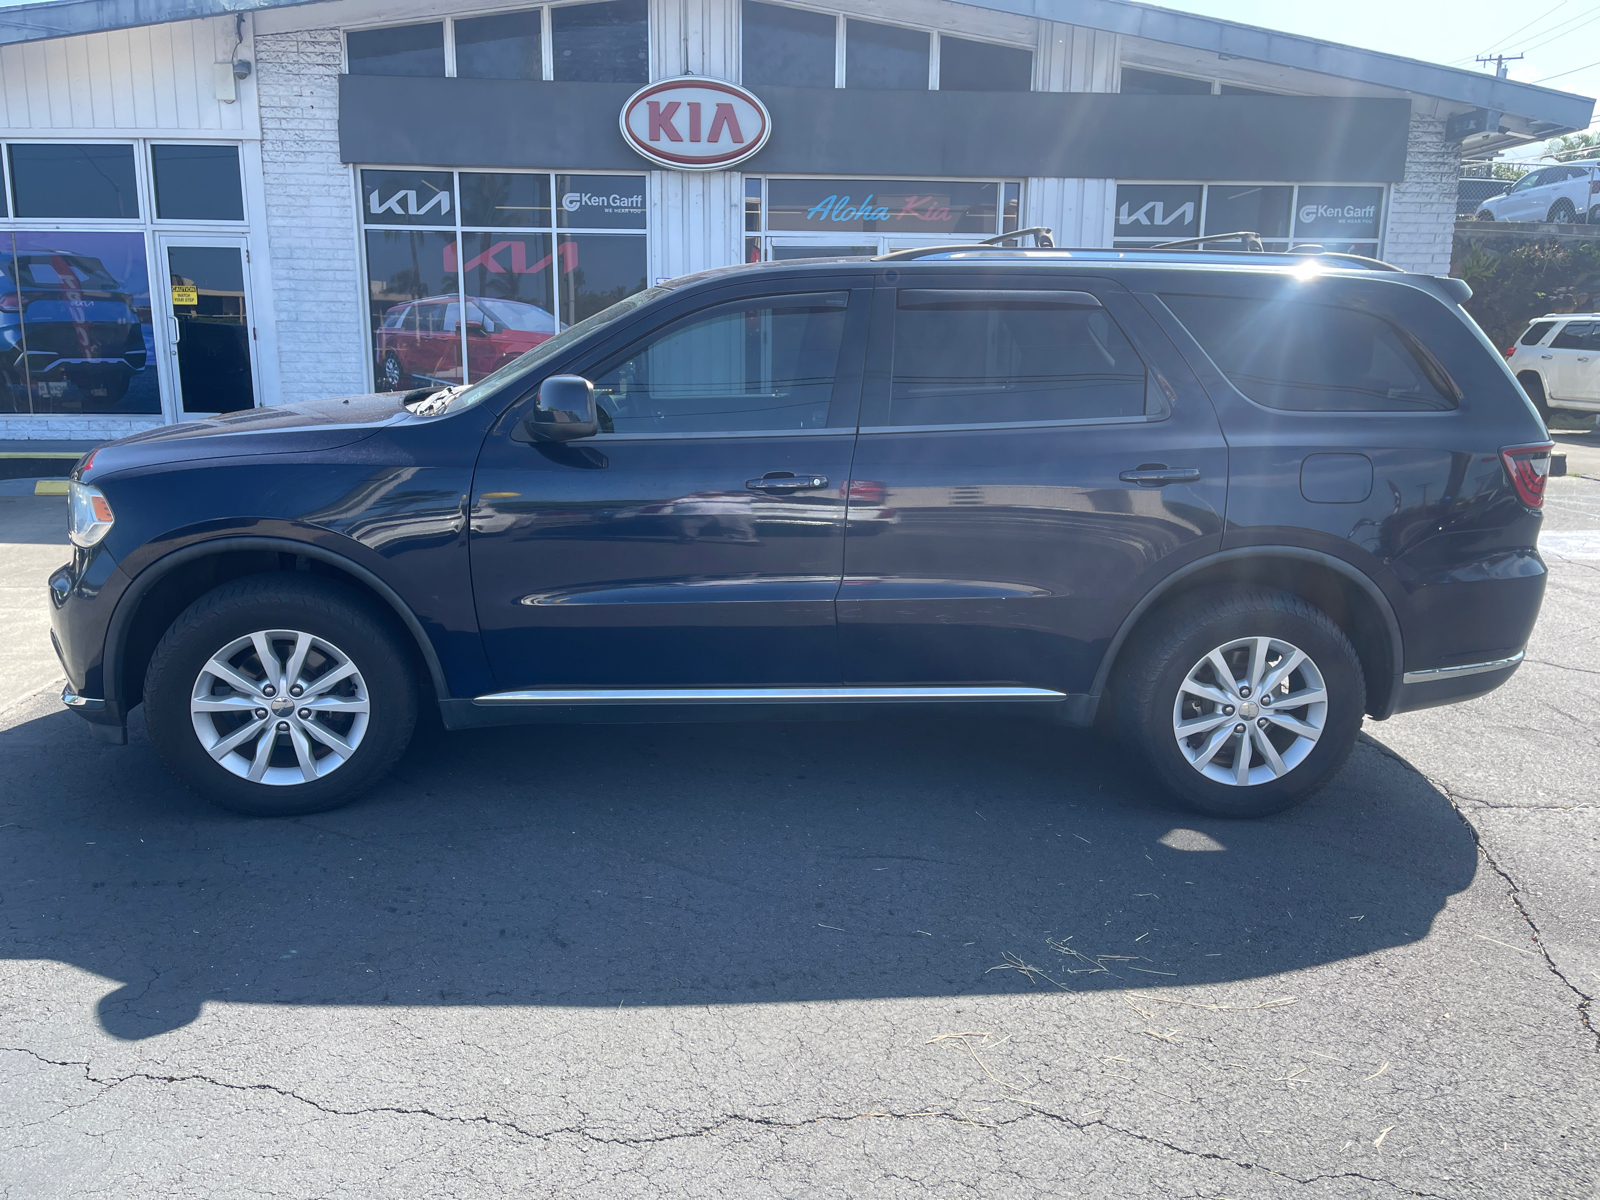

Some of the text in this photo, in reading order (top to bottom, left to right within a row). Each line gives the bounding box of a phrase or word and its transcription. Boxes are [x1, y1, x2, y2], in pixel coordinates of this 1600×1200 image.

[646, 100, 744, 143] KIA
[369, 189, 450, 216] KIA
[581, 192, 643, 207] Ken Garff
[806, 193, 952, 222] Aloha Kia
[1317, 204, 1376, 218] Ken Garff
[1119, 201, 1195, 226] KIA
